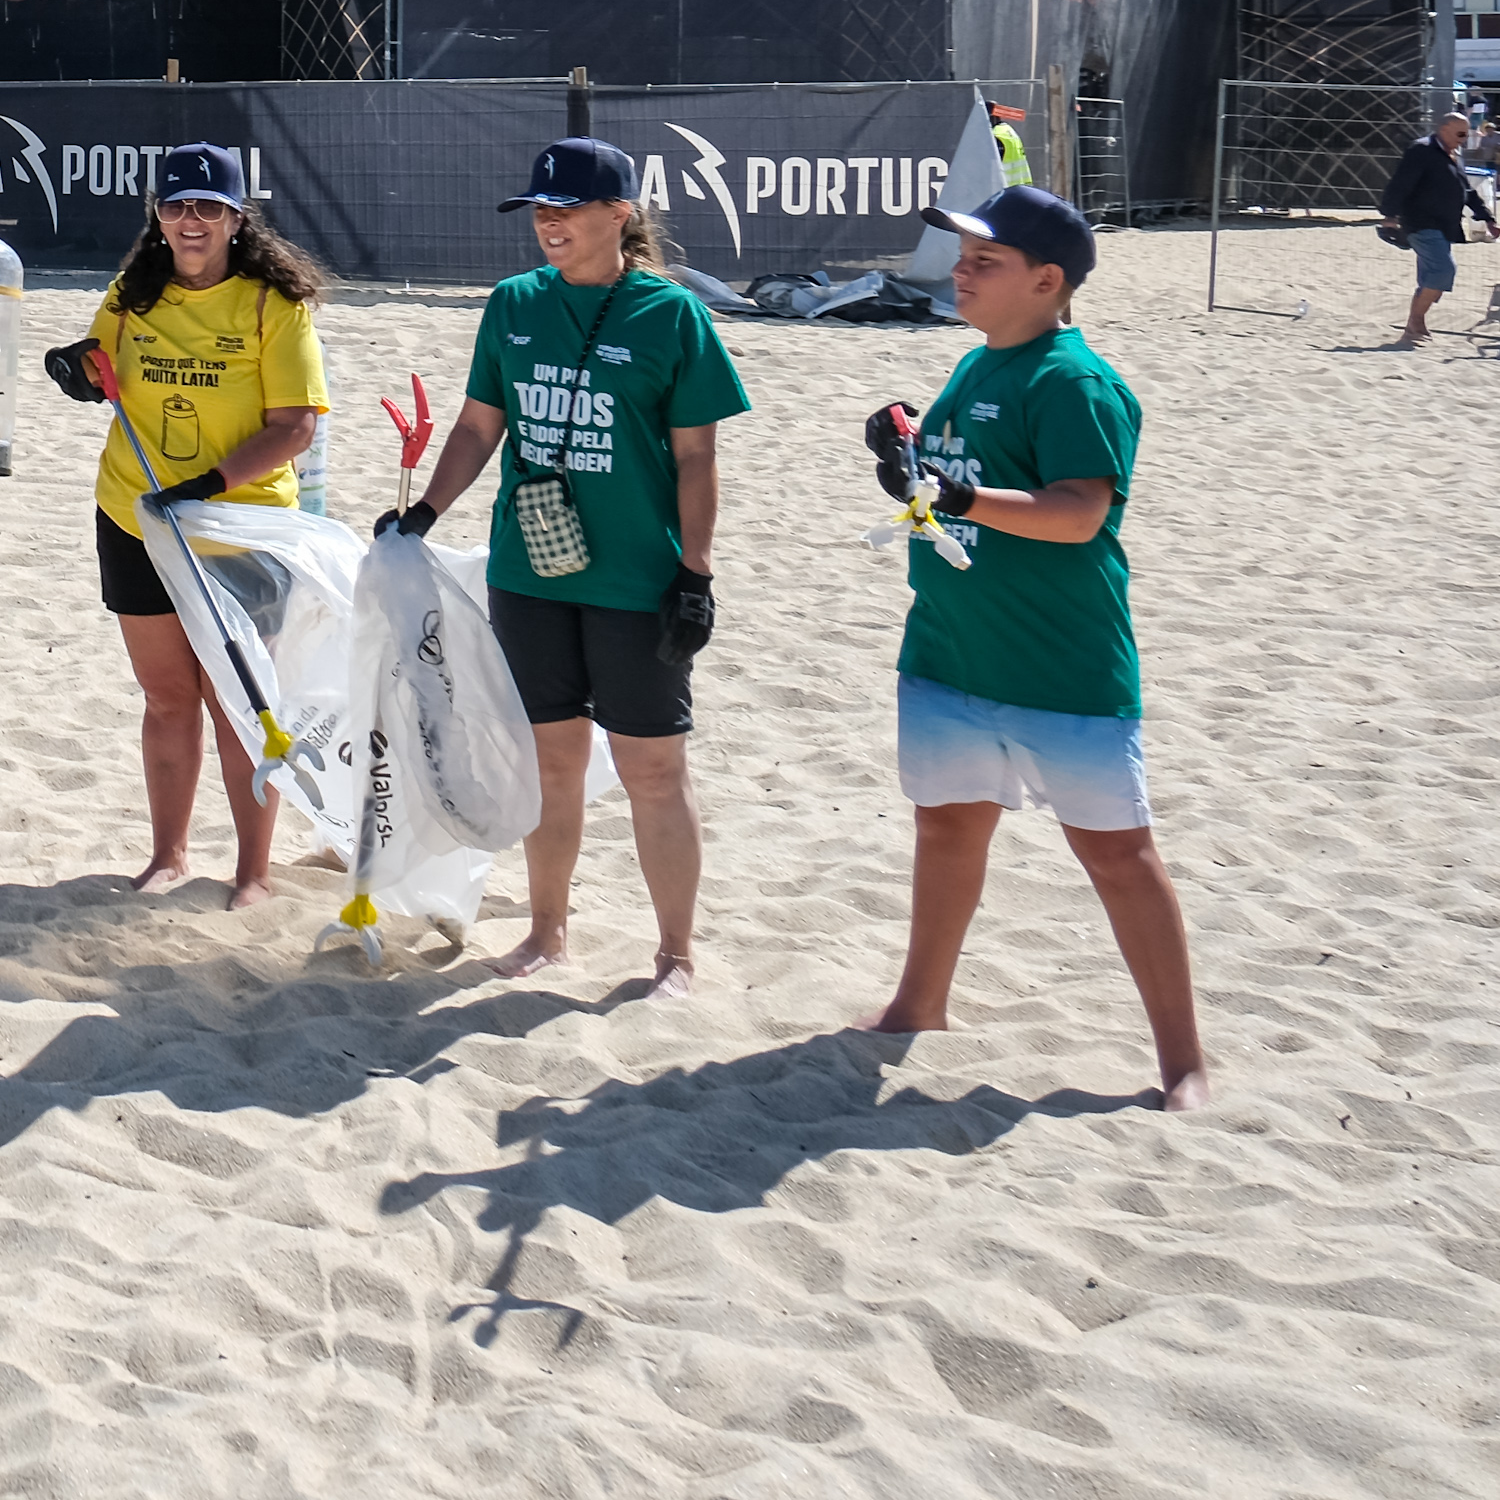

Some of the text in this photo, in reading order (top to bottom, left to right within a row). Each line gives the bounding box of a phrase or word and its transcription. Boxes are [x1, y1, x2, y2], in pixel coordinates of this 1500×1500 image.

[746, 156, 948, 217] PORTUG
[177, 357, 196, 370] QUE
[199, 360, 227, 371] TENS
[533, 363, 558, 384] UM
[142, 368, 219, 388] MUITA LATA!
[513, 381, 614, 428] TODOS
[517, 420, 529, 437] E
[571, 429, 613, 450] PELA
